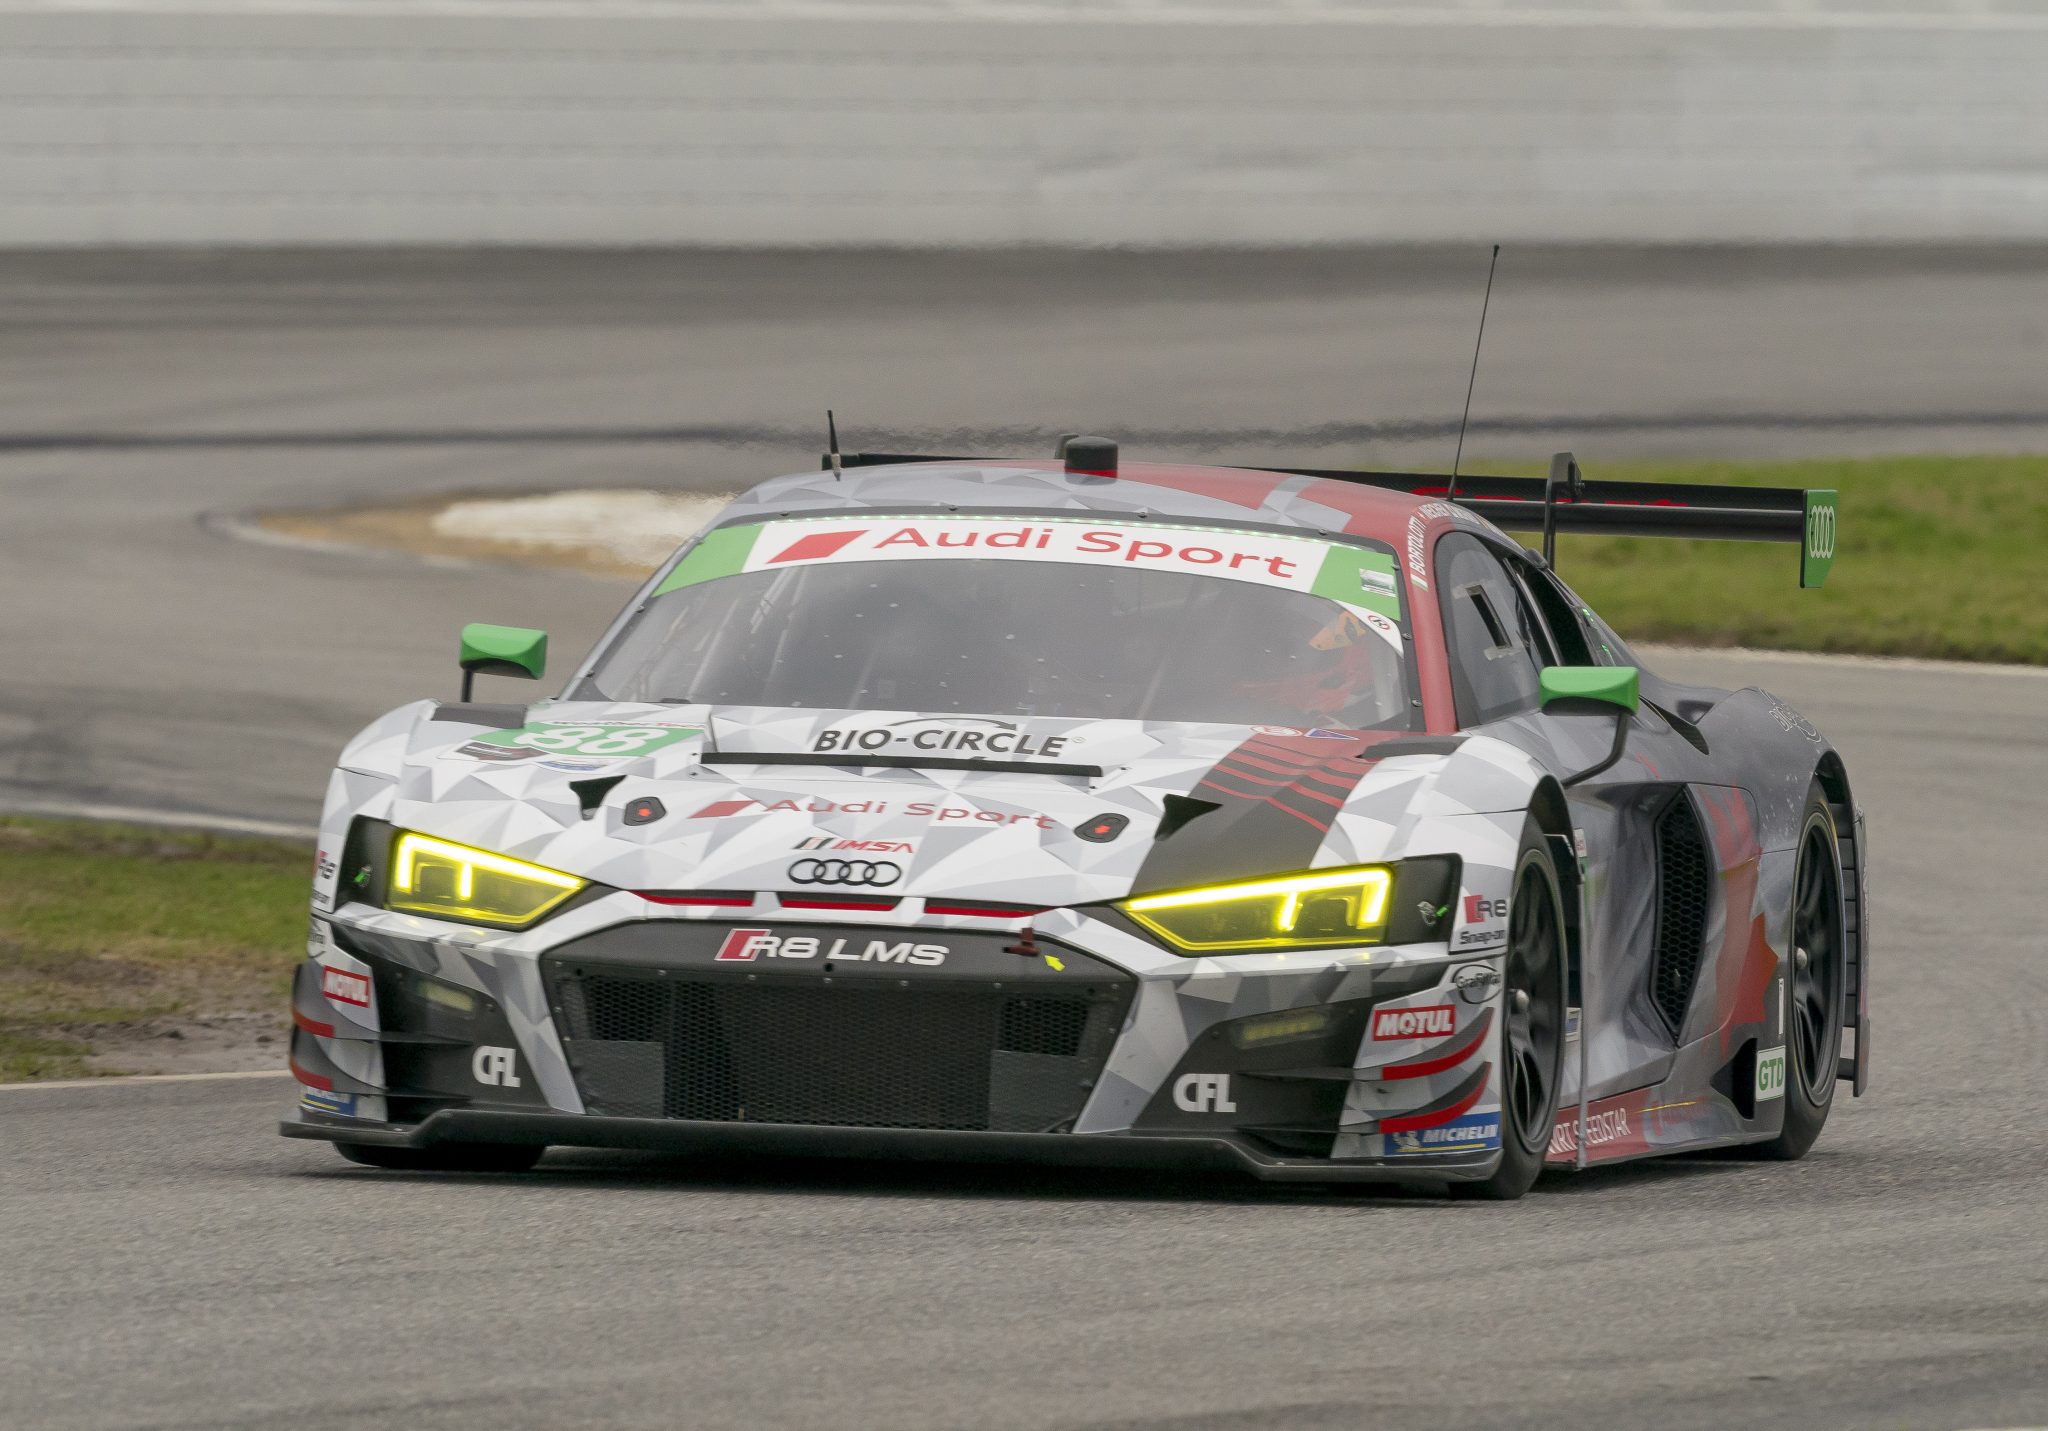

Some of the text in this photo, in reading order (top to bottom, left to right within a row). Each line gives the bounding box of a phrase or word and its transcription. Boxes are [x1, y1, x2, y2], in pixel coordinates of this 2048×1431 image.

[873, 526, 1298, 579] Audi Sport
[513, 727, 669, 754] 88
[813, 729, 1068, 758] BIO-CIRCLE
[764, 799, 1057, 830] Audi Sport
[831, 837, 913, 853] IMSA
[1477, 898, 1507, 918] R8
[739, 935, 951, 966] R8 LMS
[1376, 1009, 1453, 1036] MOTUL
[1758, 1056, 1784, 1091] GTD
[1423, 1124, 1499, 1143] MICHELIN
